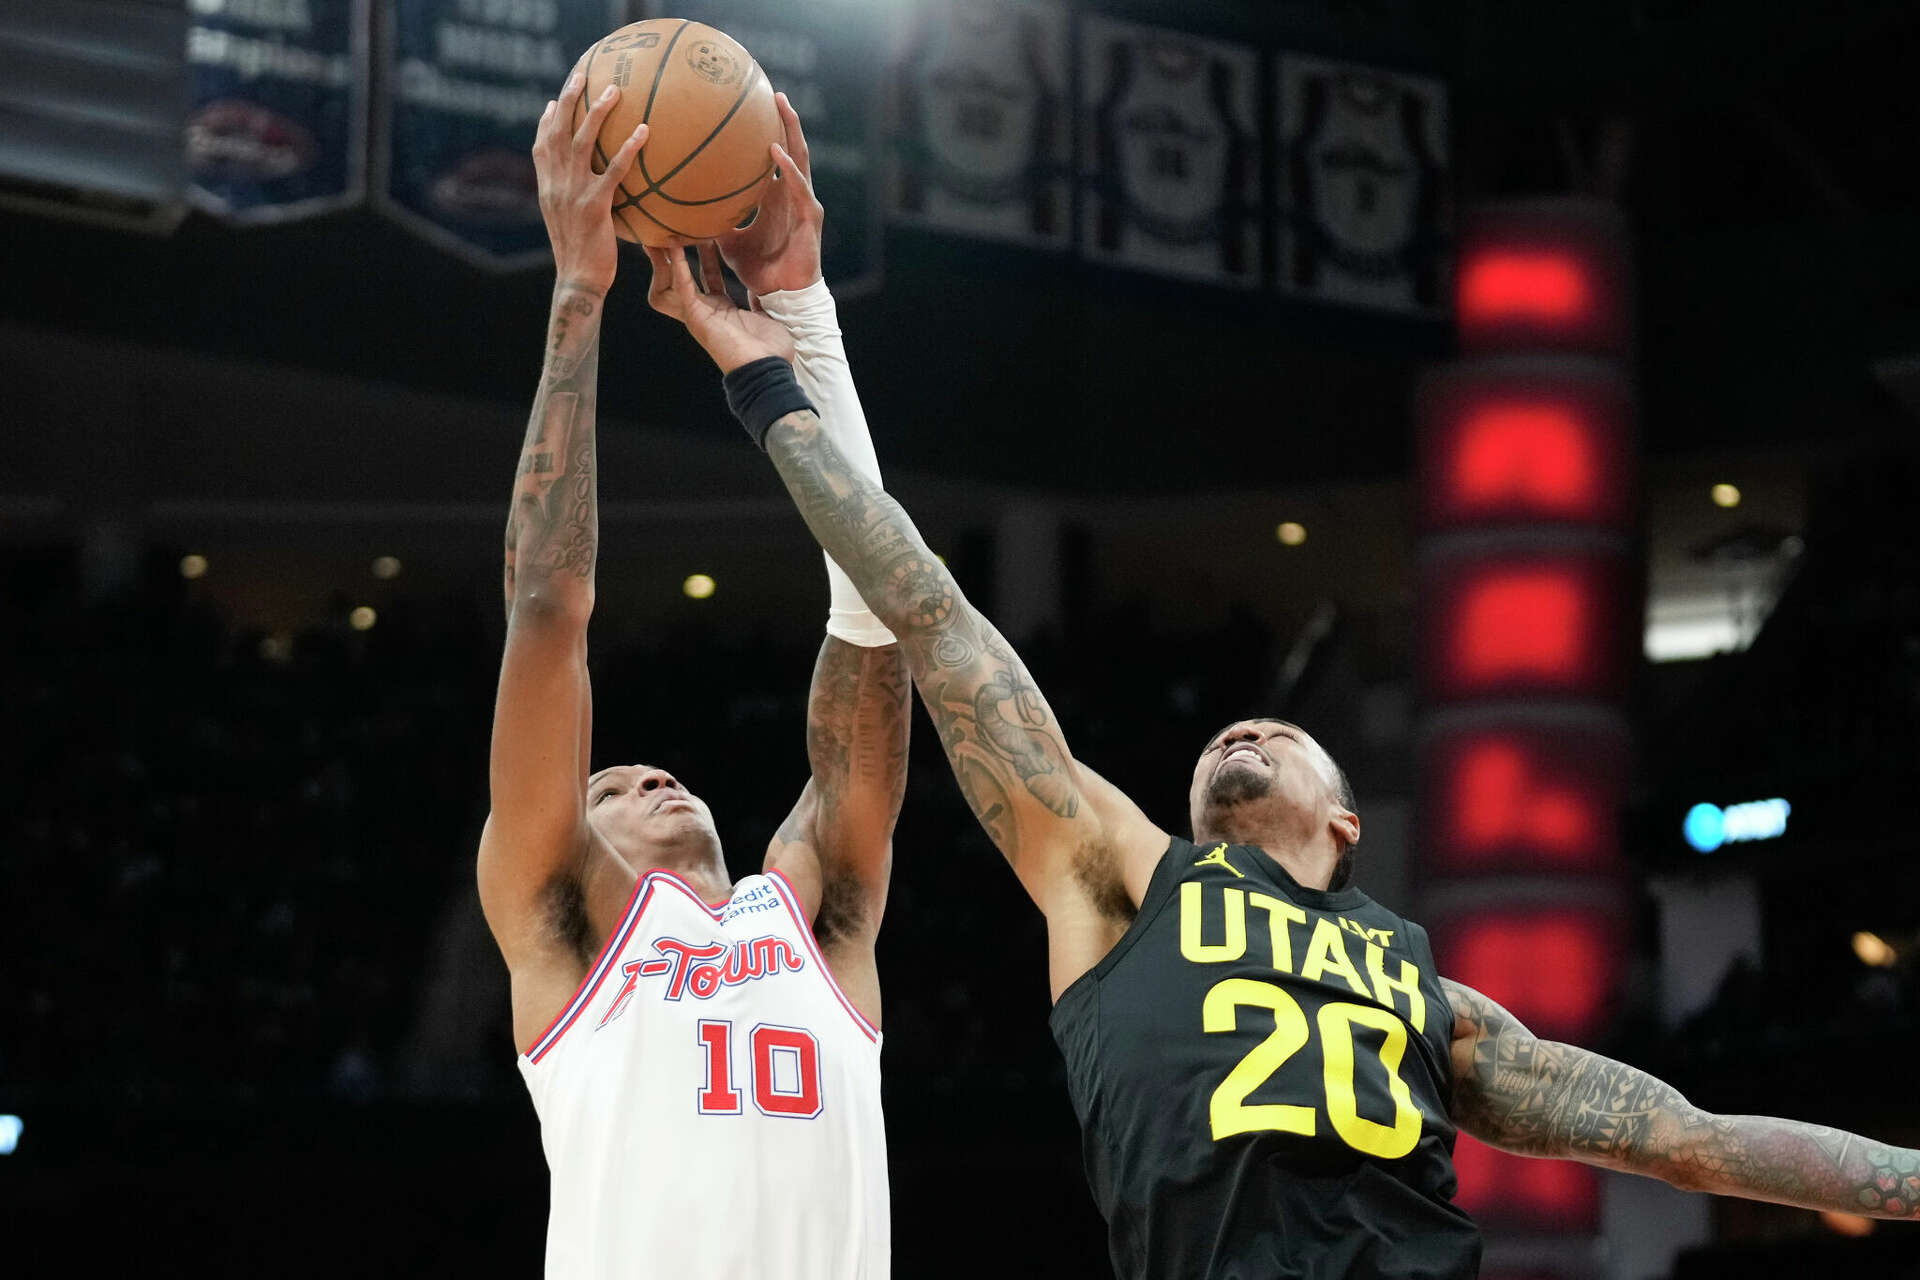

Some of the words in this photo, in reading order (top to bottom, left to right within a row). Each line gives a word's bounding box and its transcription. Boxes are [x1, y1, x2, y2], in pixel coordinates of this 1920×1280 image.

[1180, 881, 1426, 1035] UTAH
[698, 1018, 824, 1120] 10
[1203, 977, 1423, 1159] 20
